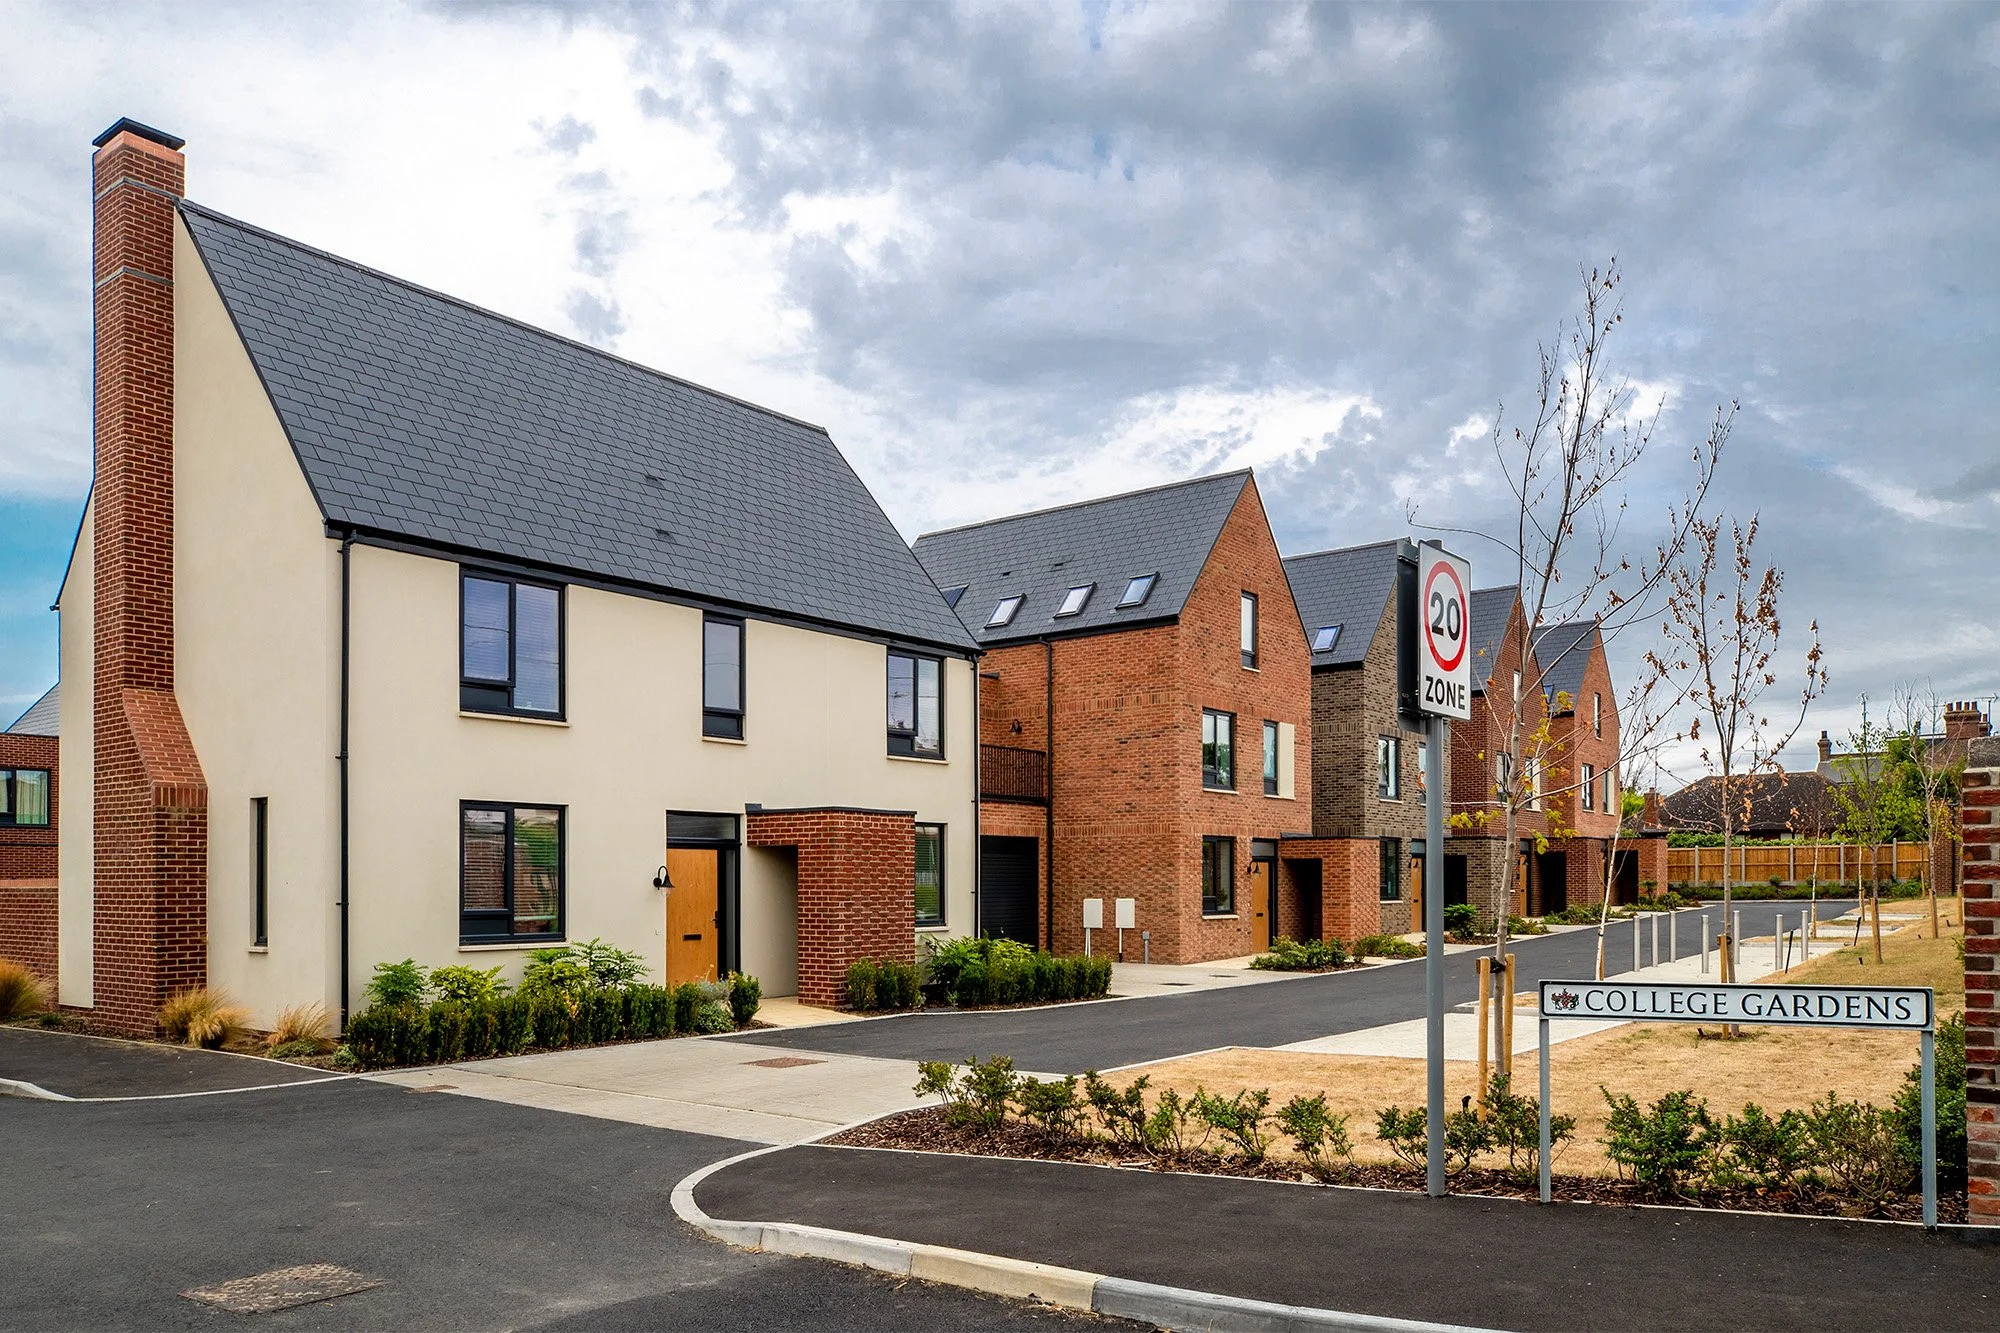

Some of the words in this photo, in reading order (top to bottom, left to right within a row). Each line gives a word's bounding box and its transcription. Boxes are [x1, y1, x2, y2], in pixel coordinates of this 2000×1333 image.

[1430, 591, 1461, 641] 20
[1425, 675, 1465, 710] ZONE
[1586, 989, 1728, 1015] COLLEGE
[1741, 993, 1911, 1020] GARDENS
